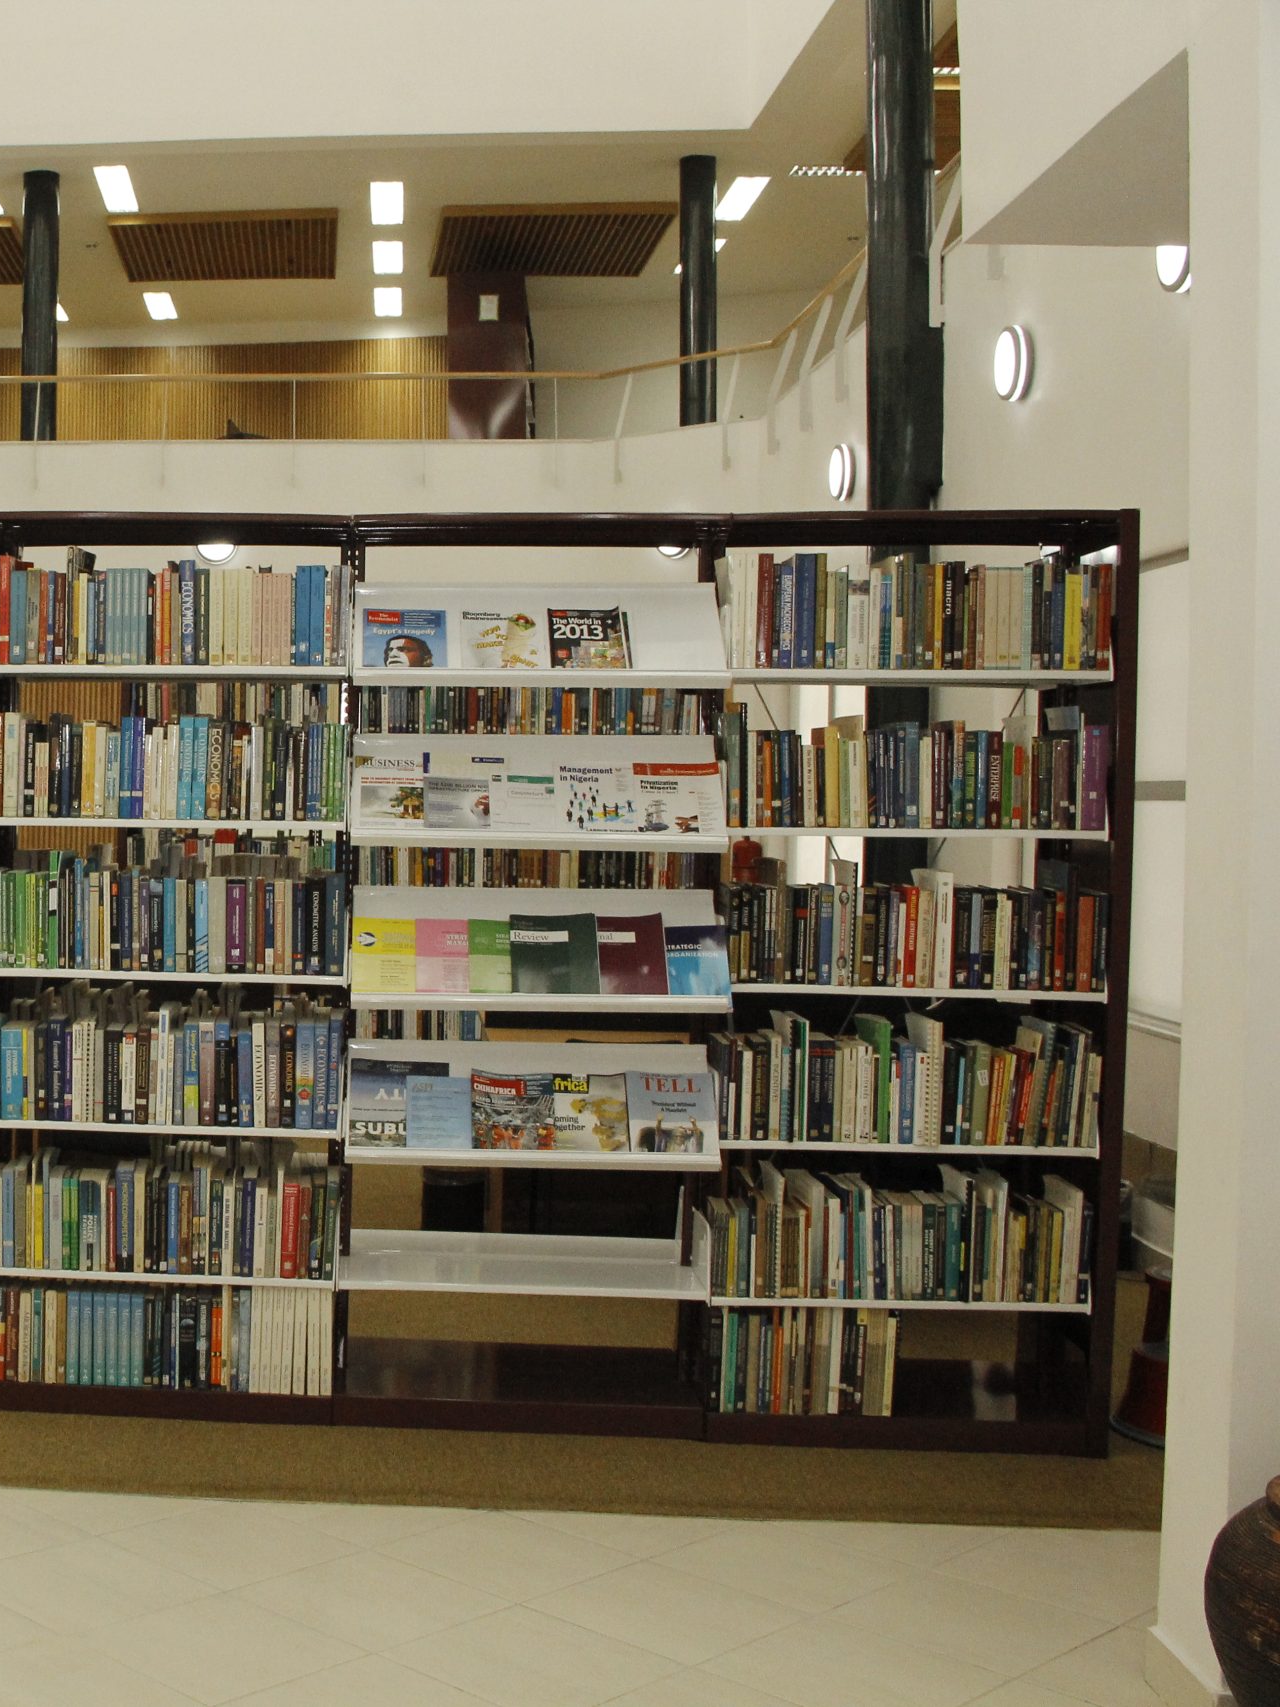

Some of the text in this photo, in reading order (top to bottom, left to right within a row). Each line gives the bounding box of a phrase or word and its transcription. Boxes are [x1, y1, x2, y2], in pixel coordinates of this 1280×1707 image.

[783, 574, 792, 603] EUROPEAN
[945, 580, 953, 616] macro
[181, 580, 194, 635] ECONOMICS
[551, 617, 568, 625] The
[567, 617, 593, 625] World
[372, 627, 436, 636] Egypt's tragedy
[552, 623, 604, 640] 2013
[182, 727, 193, 783] ECONOMICS
[197, 727, 208, 784] ECONOMICS
[208, 728, 222, 801] ECONOMICS
[361, 758, 417, 769] BUSINESS
[559, 765, 614, 776] Management
[559, 774, 600, 784] in Nigeria
[639, 779, 680, 787] Privatization
[990, 754, 1000, 802] ENTERPRISE
[311, 891, 320, 952] ECONOMETRIC ANALYSIS
[513, 930, 550, 942] Review
[254, 1044, 265, 1103] ECONOMICS
[268, 1054, 278, 1100] ECONOMICS
[284, 1051, 294, 1094] ECONOMICS
[315, 1047, 328, 1106] ECONOMICS
[552, 1077, 589, 1092] frica
[644, 1076, 702, 1093] TELL
[472, 1082, 518, 1096] CHINAFRICA
[121, 1182, 129, 1252] MICROECONOMETRICS
